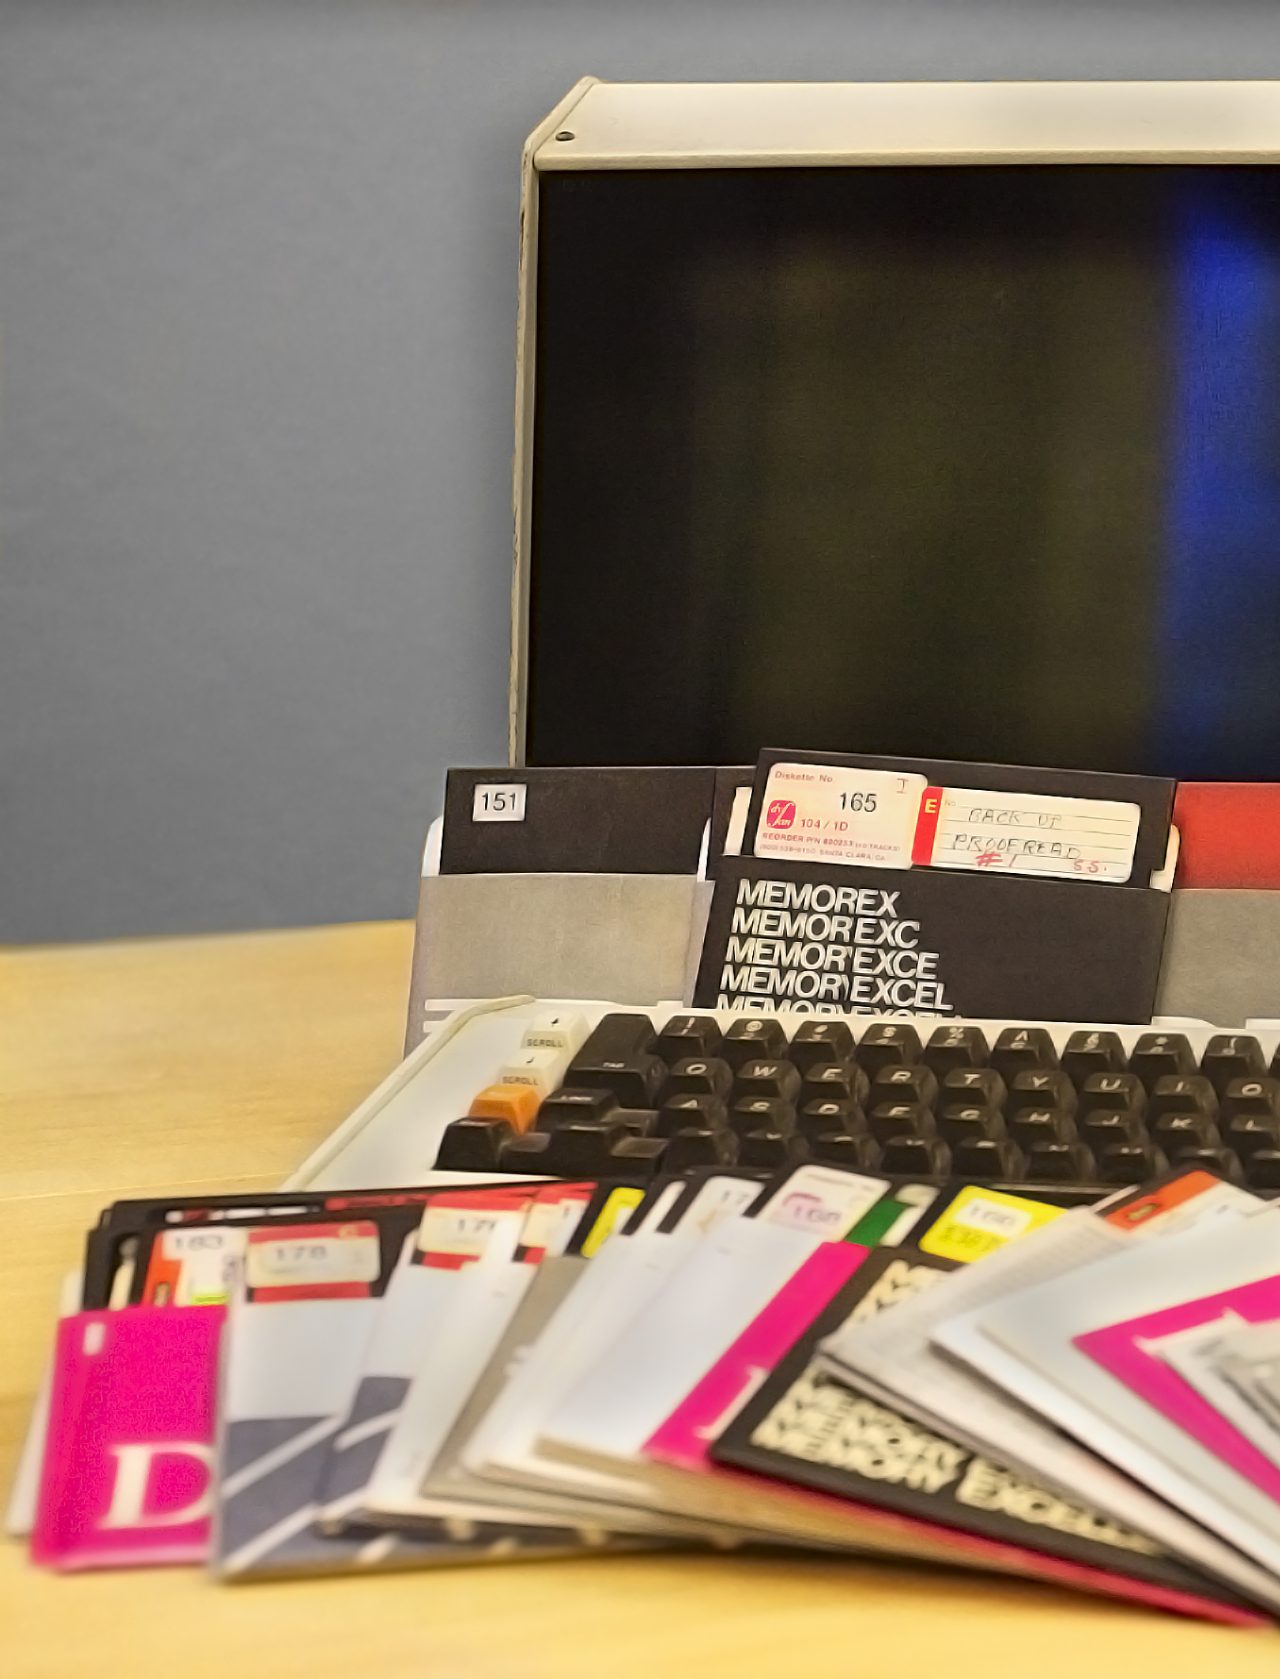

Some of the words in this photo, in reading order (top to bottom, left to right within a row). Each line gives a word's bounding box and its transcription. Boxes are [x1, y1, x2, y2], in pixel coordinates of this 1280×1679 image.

[774, 770, 815, 783] Diskette
[481, 792, 517, 811] 151
[839, 792, 877, 813] 165
[924, 799, 938, 813] E
[968, 808, 1023, 825] BACK
[1038, 814, 1062, 829] UP
[762, 832, 804, 843] REORDER
[952, 833, 1082, 860] PROOFREAD
[736, 878, 900, 918] MEMOREX
[526, 1039, 564, 1048] SCROLL
[502, 1076, 539, 1085] SCROLL
